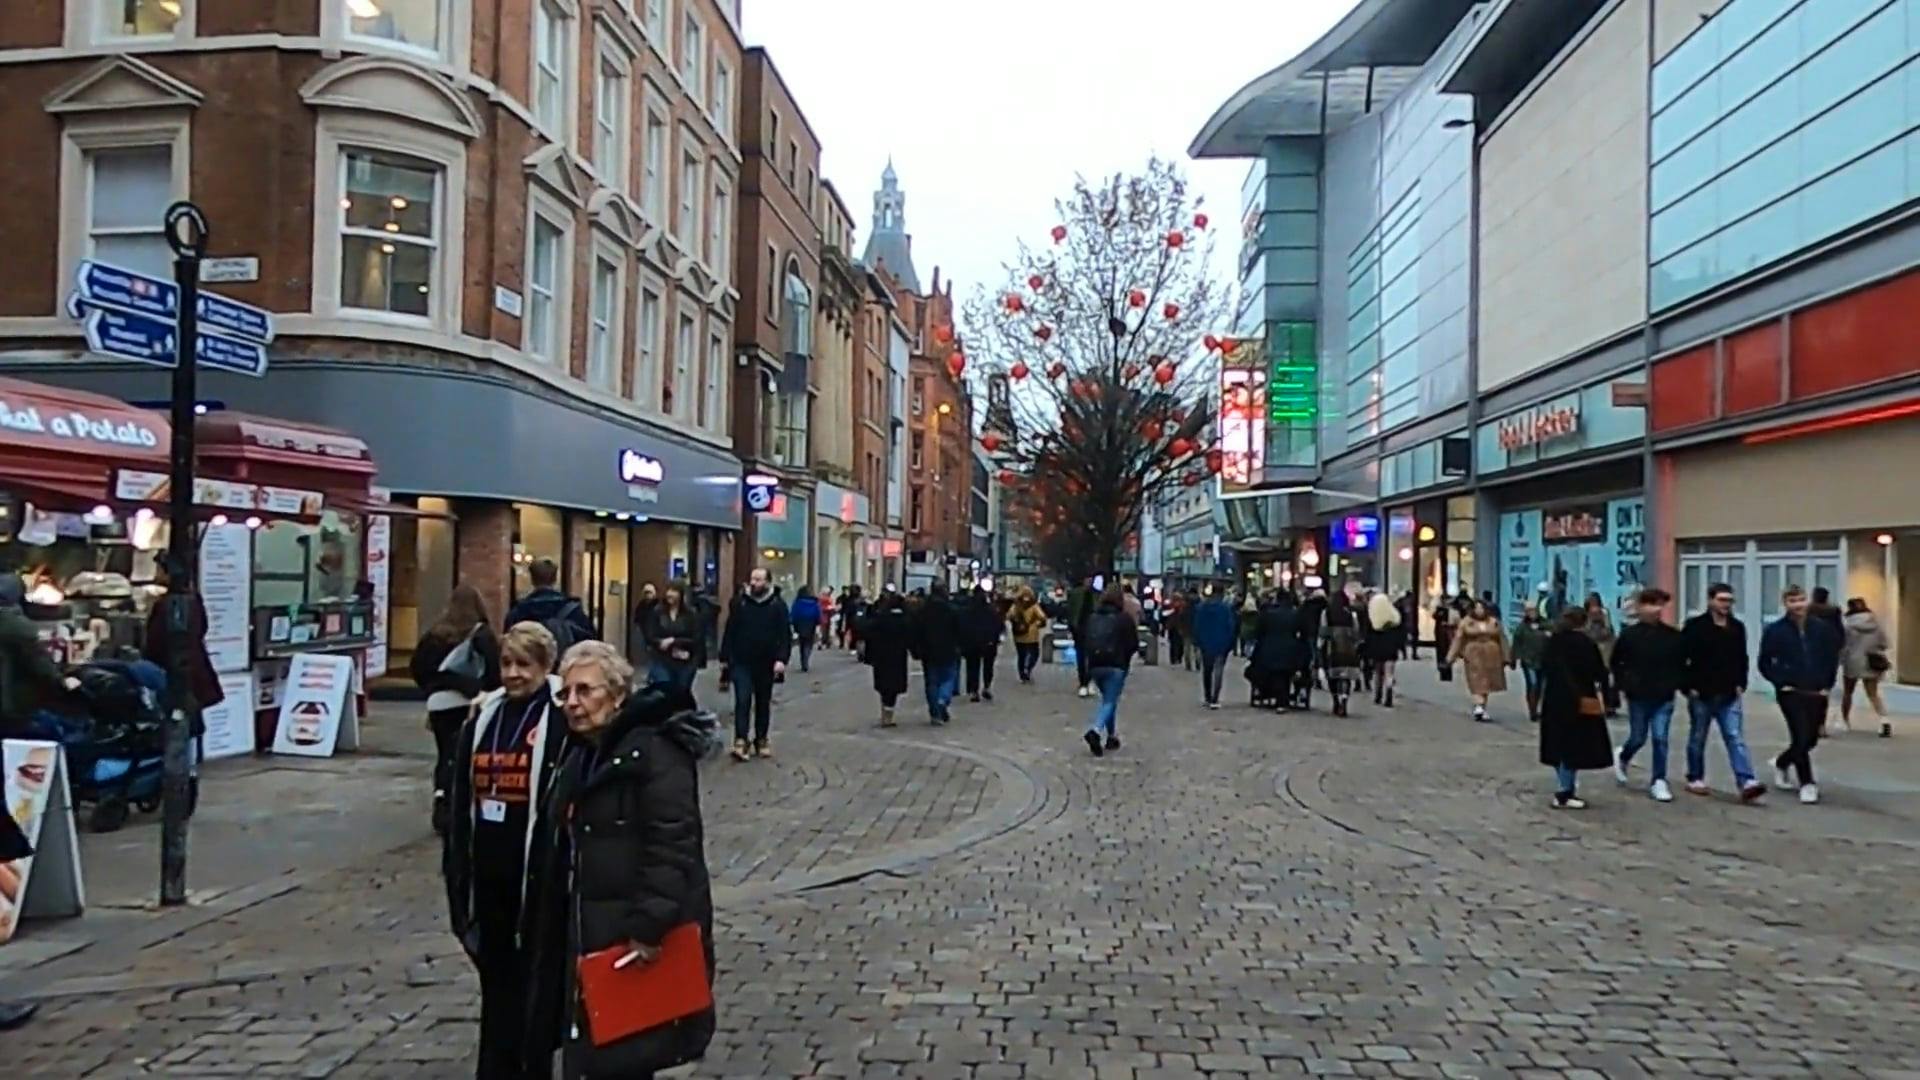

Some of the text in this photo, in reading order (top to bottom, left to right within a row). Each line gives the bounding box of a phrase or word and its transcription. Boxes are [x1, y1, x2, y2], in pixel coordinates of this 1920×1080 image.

[51, 416, 72, 437] a
[70, 412, 157, 446] Potato
[1617, 506, 1632, 528] ON
[1617, 560, 1645, 586] SIN
